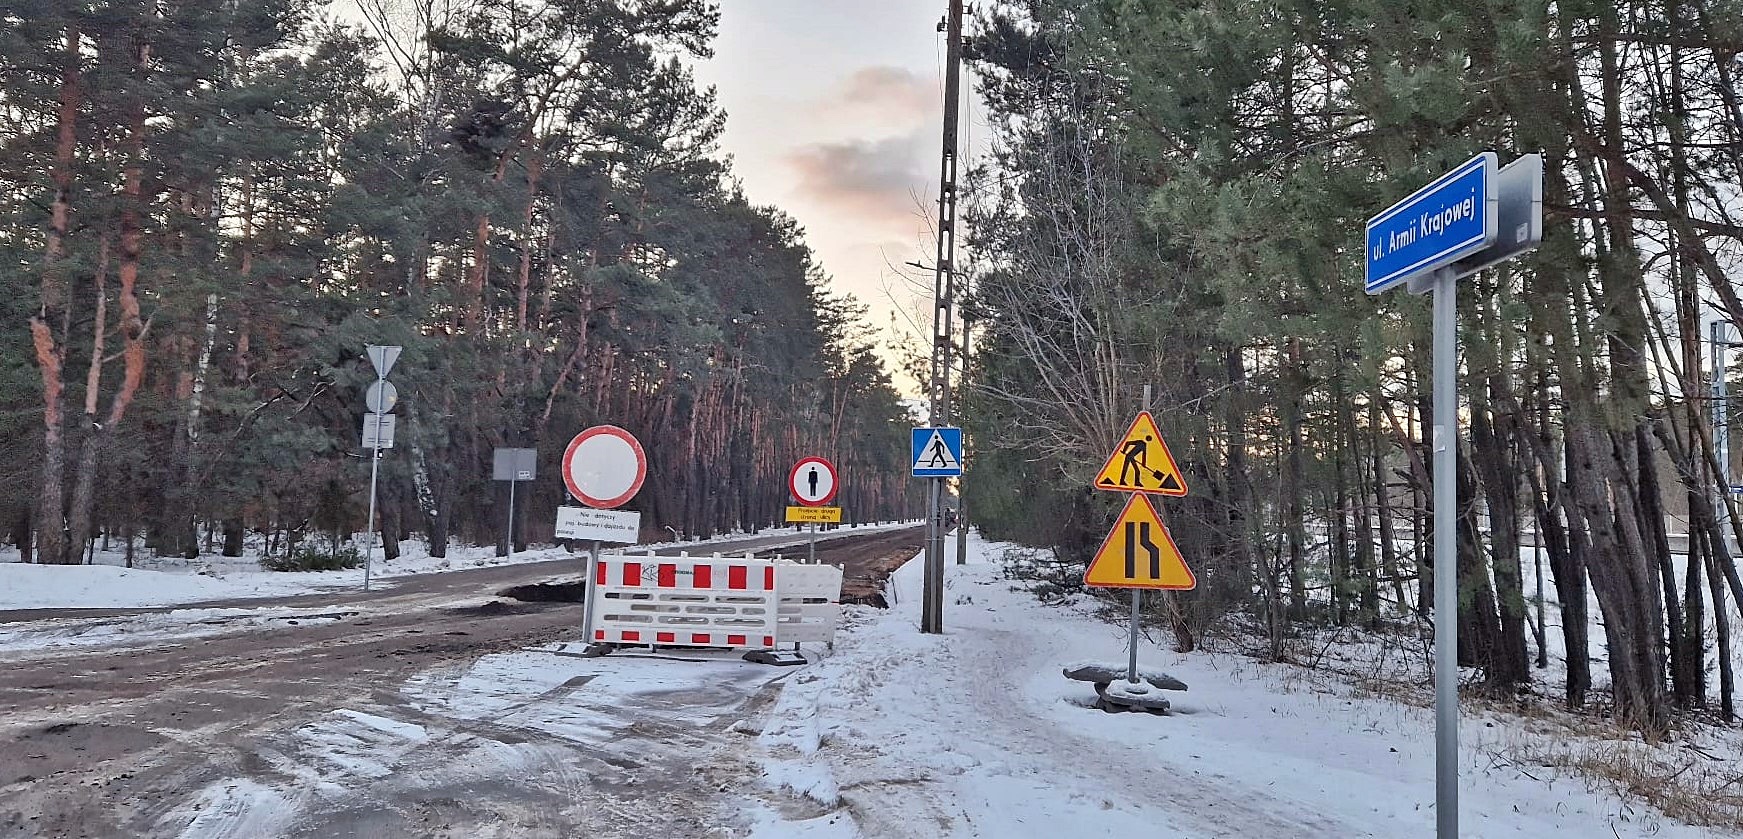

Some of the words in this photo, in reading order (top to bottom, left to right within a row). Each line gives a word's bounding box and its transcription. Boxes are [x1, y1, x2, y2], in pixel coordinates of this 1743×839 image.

[1373, 236, 1385, 262] ul.
[1388, 219, 1416, 255] Armii
[1420, 187, 1475, 238] Krajowej
[595, 513, 615, 521] dotyczy
